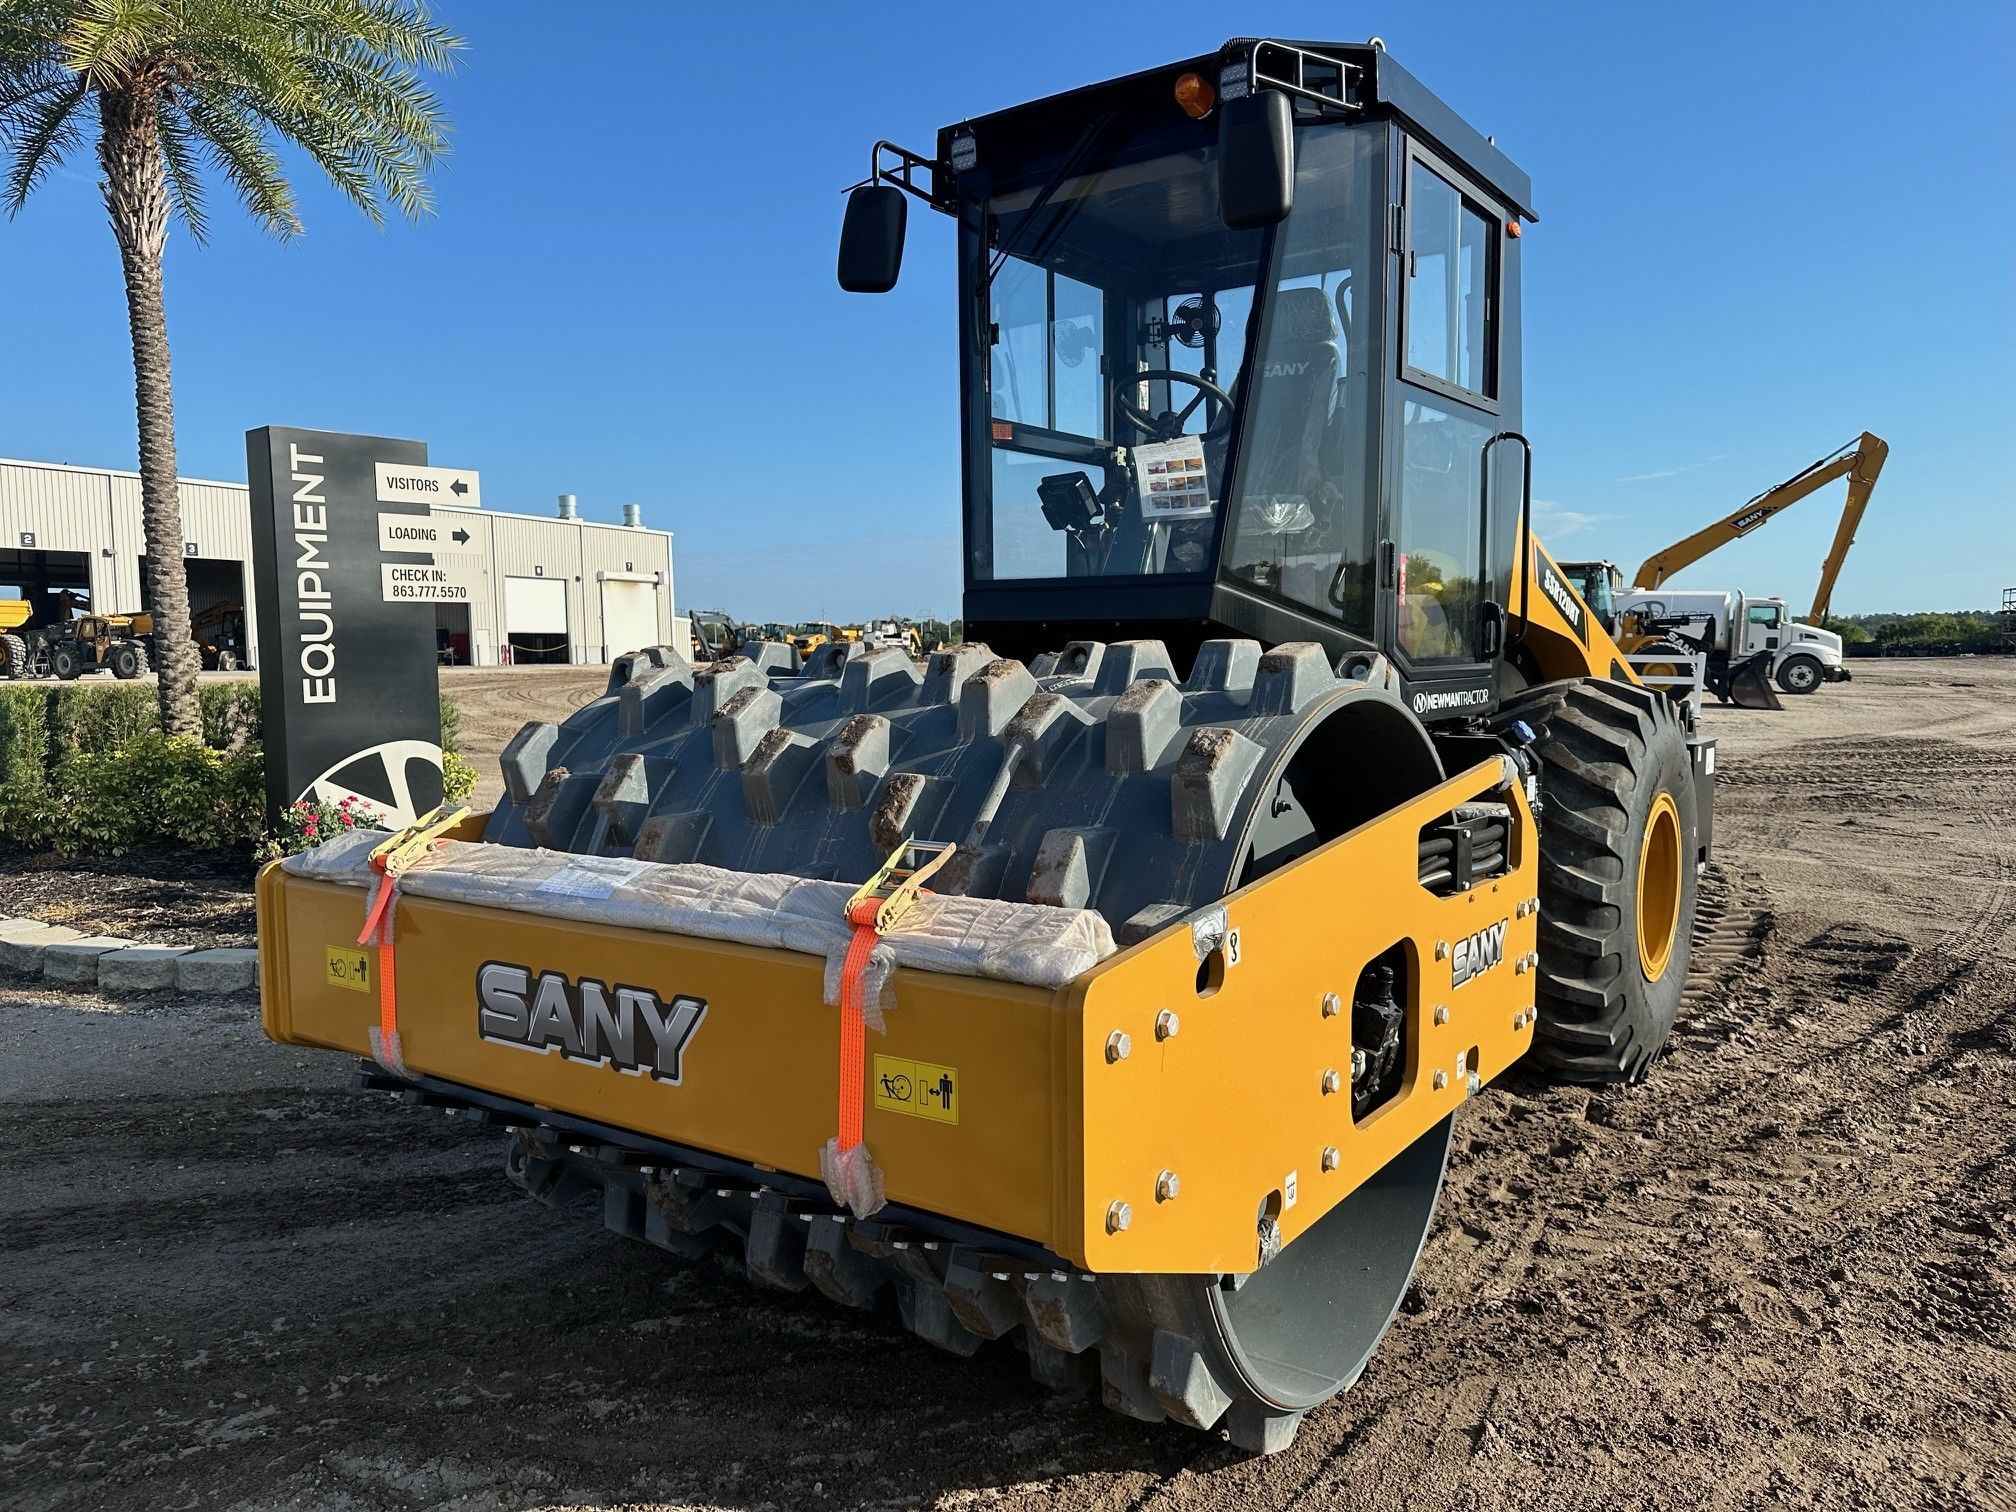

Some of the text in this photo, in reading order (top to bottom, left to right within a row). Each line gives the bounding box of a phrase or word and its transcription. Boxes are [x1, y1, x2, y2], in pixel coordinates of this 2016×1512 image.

[386, 476, 439, 492] VISITORS
[1737, 509, 1763, 527] SANY
[388, 526, 437, 541] LOADING
[290, 443, 336, 703] EQUIPMENT
[391, 568, 447, 582] CHECK IN:
[392, 585, 467, 598] 863.777.5570
[1452, 917, 1508, 991] SANY
[477, 961, 707, 1085] SANY
